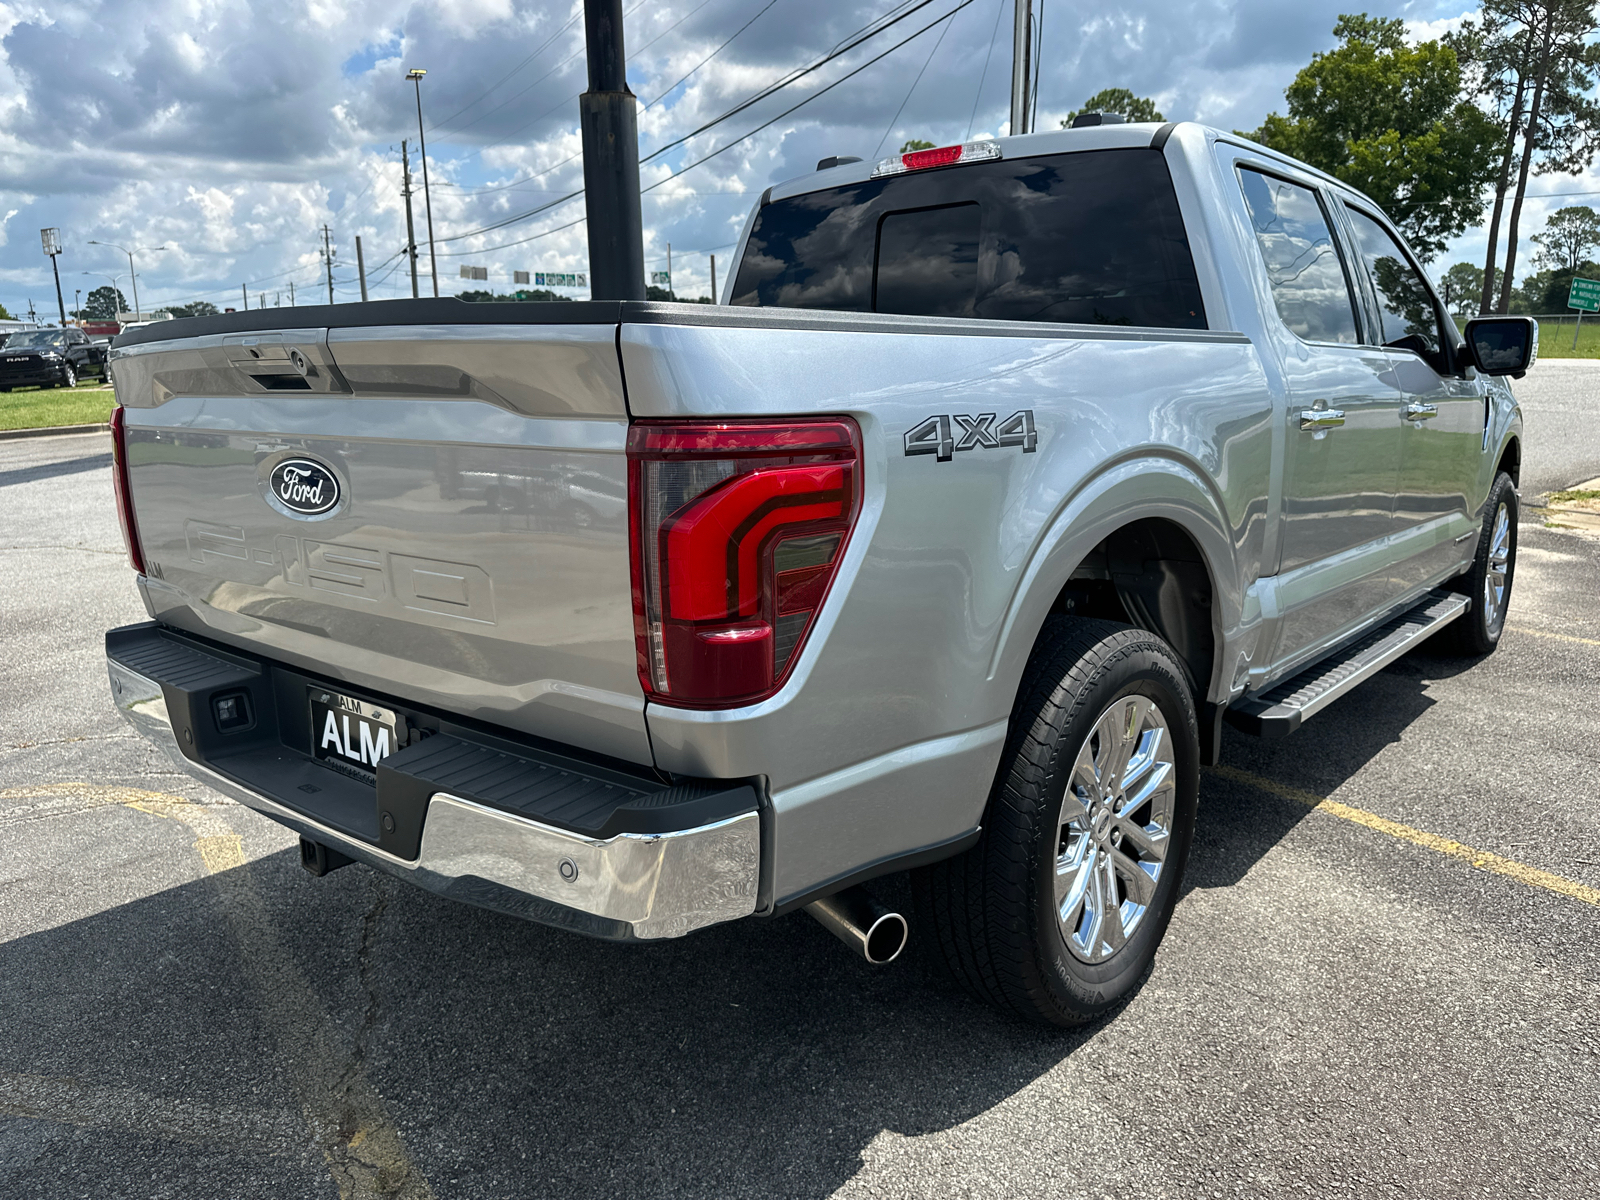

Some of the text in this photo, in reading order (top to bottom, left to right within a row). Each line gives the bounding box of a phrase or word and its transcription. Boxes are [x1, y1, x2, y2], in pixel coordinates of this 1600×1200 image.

[281, 466, 324, 505] Ford
[146, 560, 165, 580] ALM
[184, 518, 497, 626] F-150
[340, 696, 362, 714] ALM
[321, 710, 390, 768] ALM
